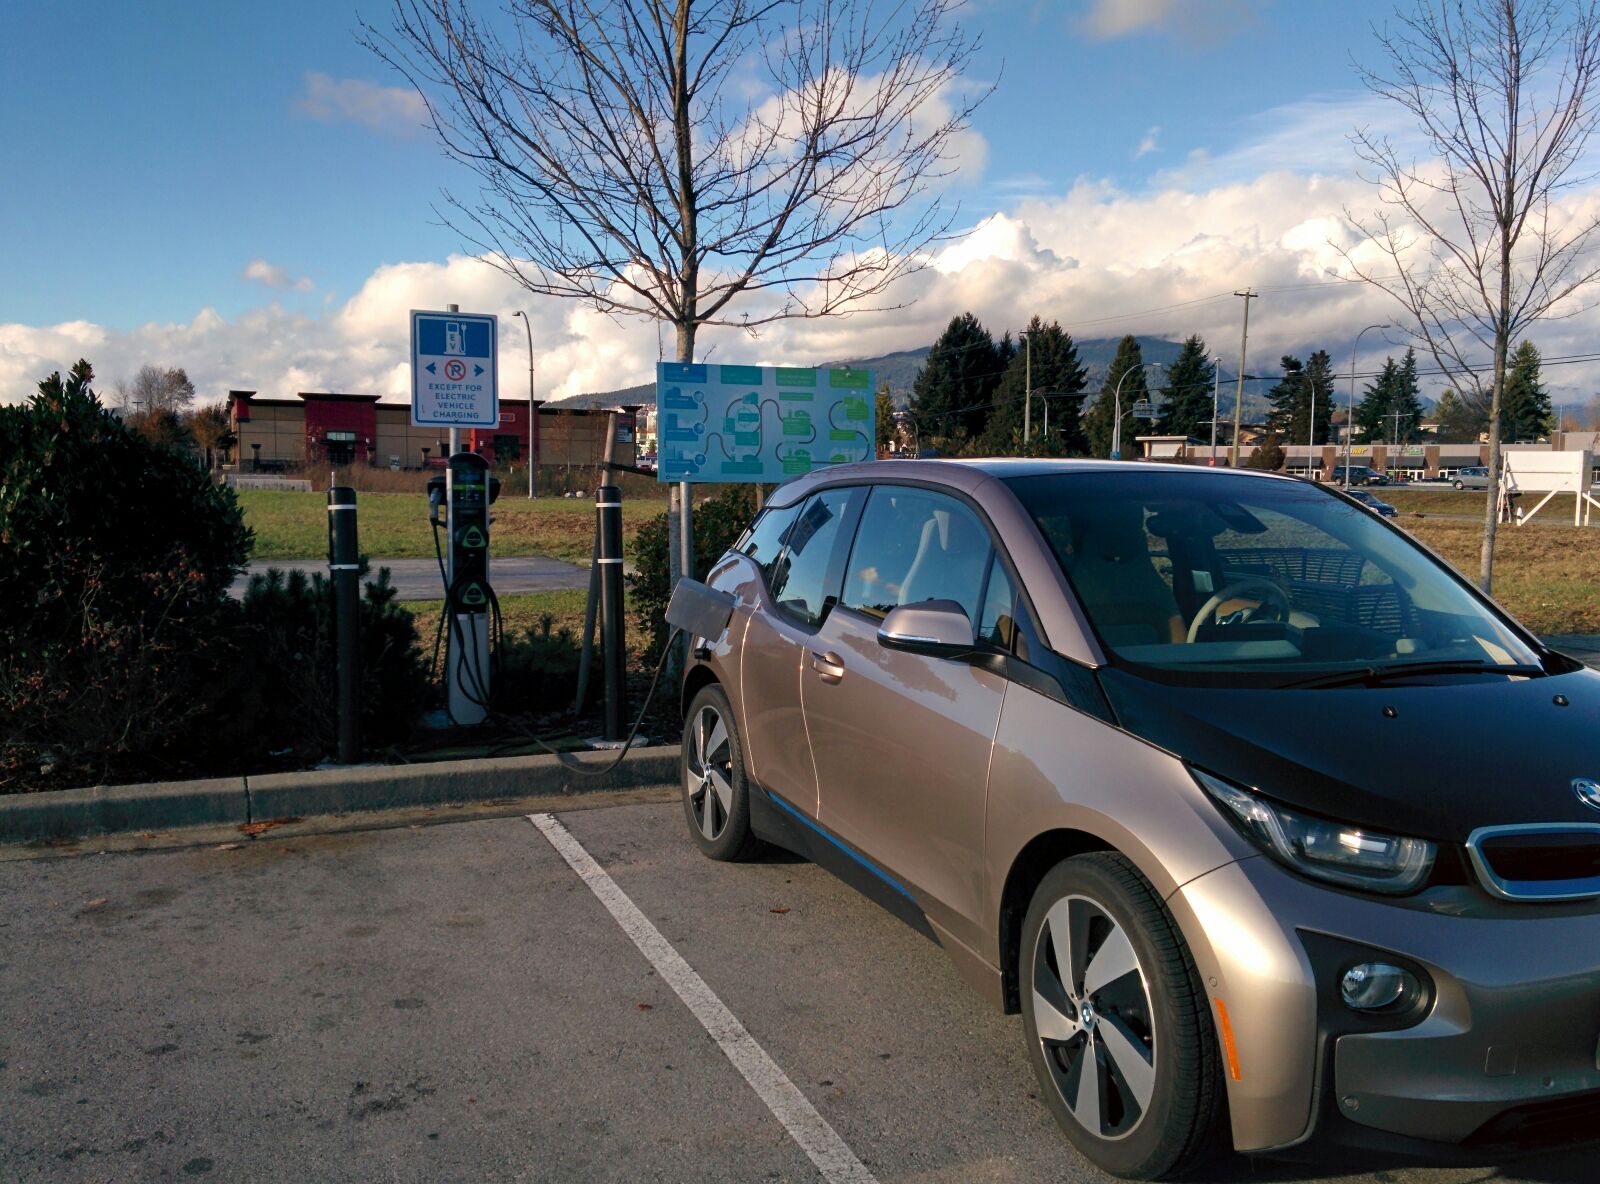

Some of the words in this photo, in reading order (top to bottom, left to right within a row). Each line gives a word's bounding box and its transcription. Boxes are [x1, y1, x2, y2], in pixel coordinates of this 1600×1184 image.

[435, 393, 476, 401] ELECTRIC
[438, 402, 474, 410] VEHICLE
[433, 411, 479, 419] CHARGING
